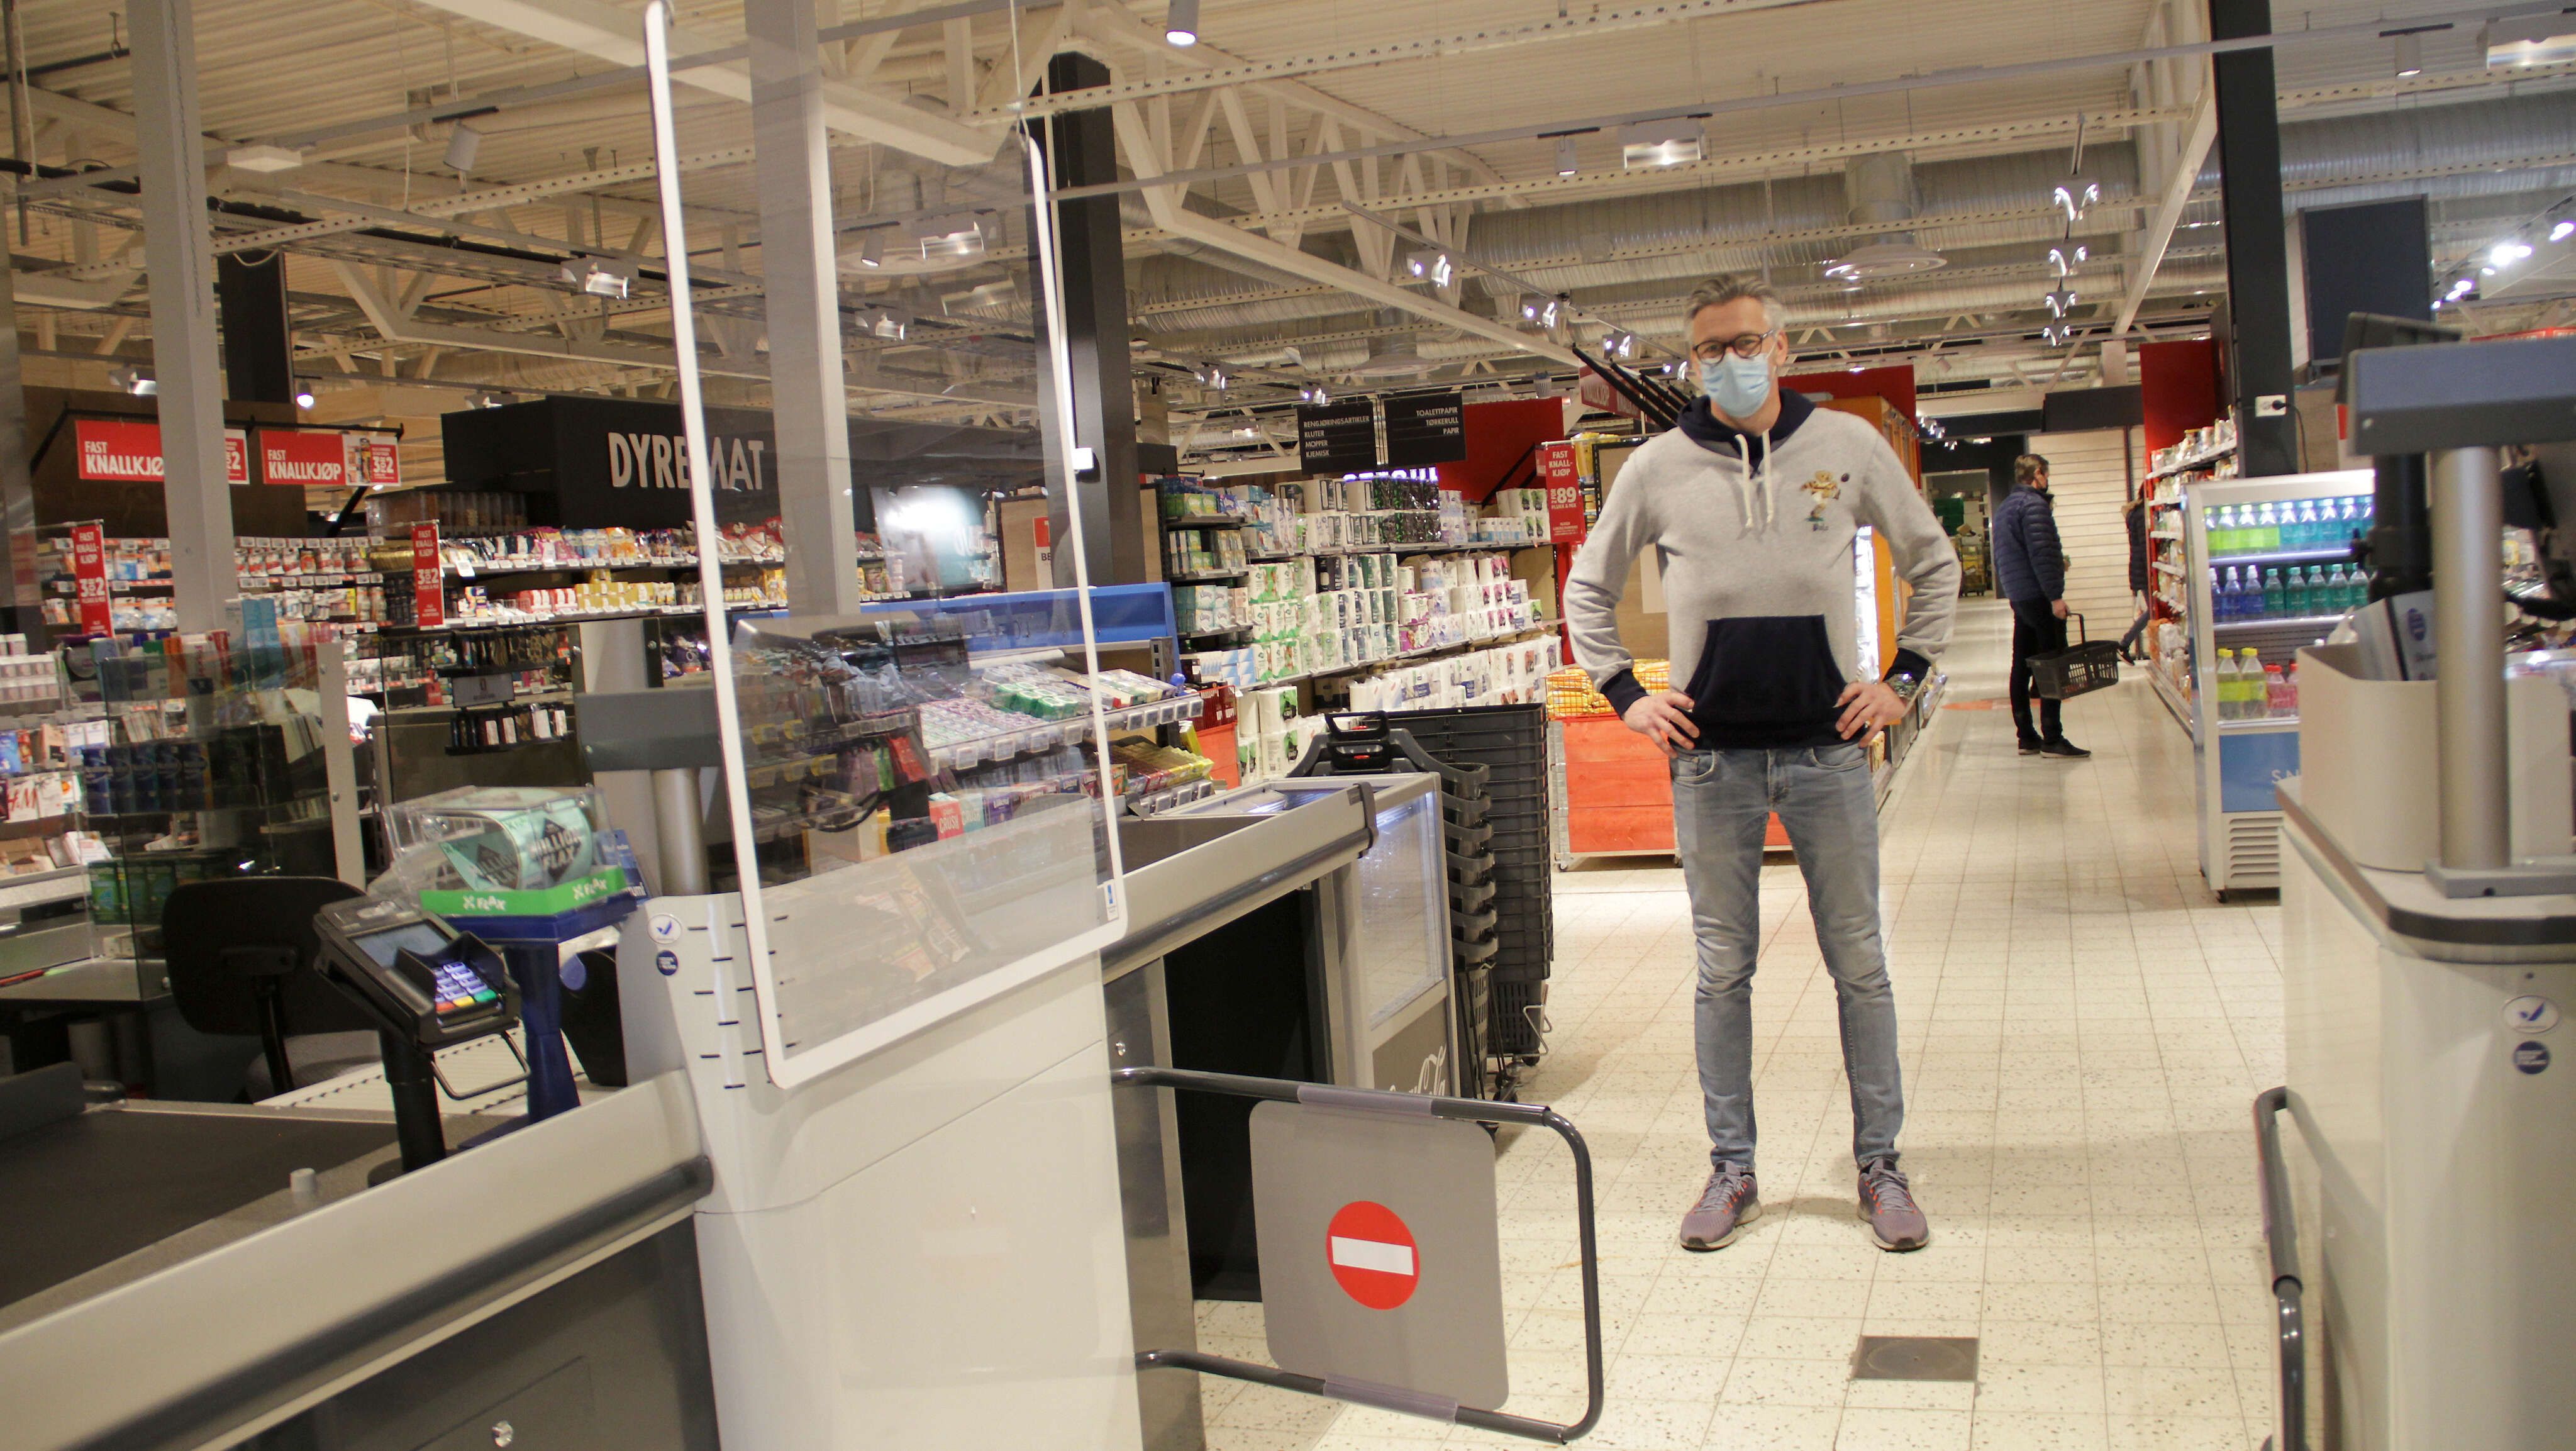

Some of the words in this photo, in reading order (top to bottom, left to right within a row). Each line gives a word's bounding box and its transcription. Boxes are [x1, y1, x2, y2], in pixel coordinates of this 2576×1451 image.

[1416, 407, 1458, 417] TOALETTPAPIR
[1304, 415, 1370, 428] RENGJØRINGSARTIKLER
[1426, 416, 1459, 426] TØRKERULL
[1443, 426, 1460, 435] PAPIR
[84, 441, 108, 454] FAST
[1305, 440, 1328, 448] MOPPER
[267, 449, 286, 460] FAST
[1306, 450, 1330, 459] KJEMISK
[1552, 450, 1568, 459] FAST
[86, 454, 164, 476] KNALLKJØ
[268, 461, 342, 480] KNALLKJØP
[372, 456, 380, 473] 3
[386, 456, 394, 473] 2
[1548, 460, 1573, 469] KNALL-
[1552, 469, 1570, 477] KJØP
[1557, 486, 1577, 503] 89
[417, 569, 425, 585] 3
[431, 567, 439, 584] 2
[79, 578, 89, 597] 3
[95, 577, 106, 596] 2
[939, 815, 960, 834] CRUSH
